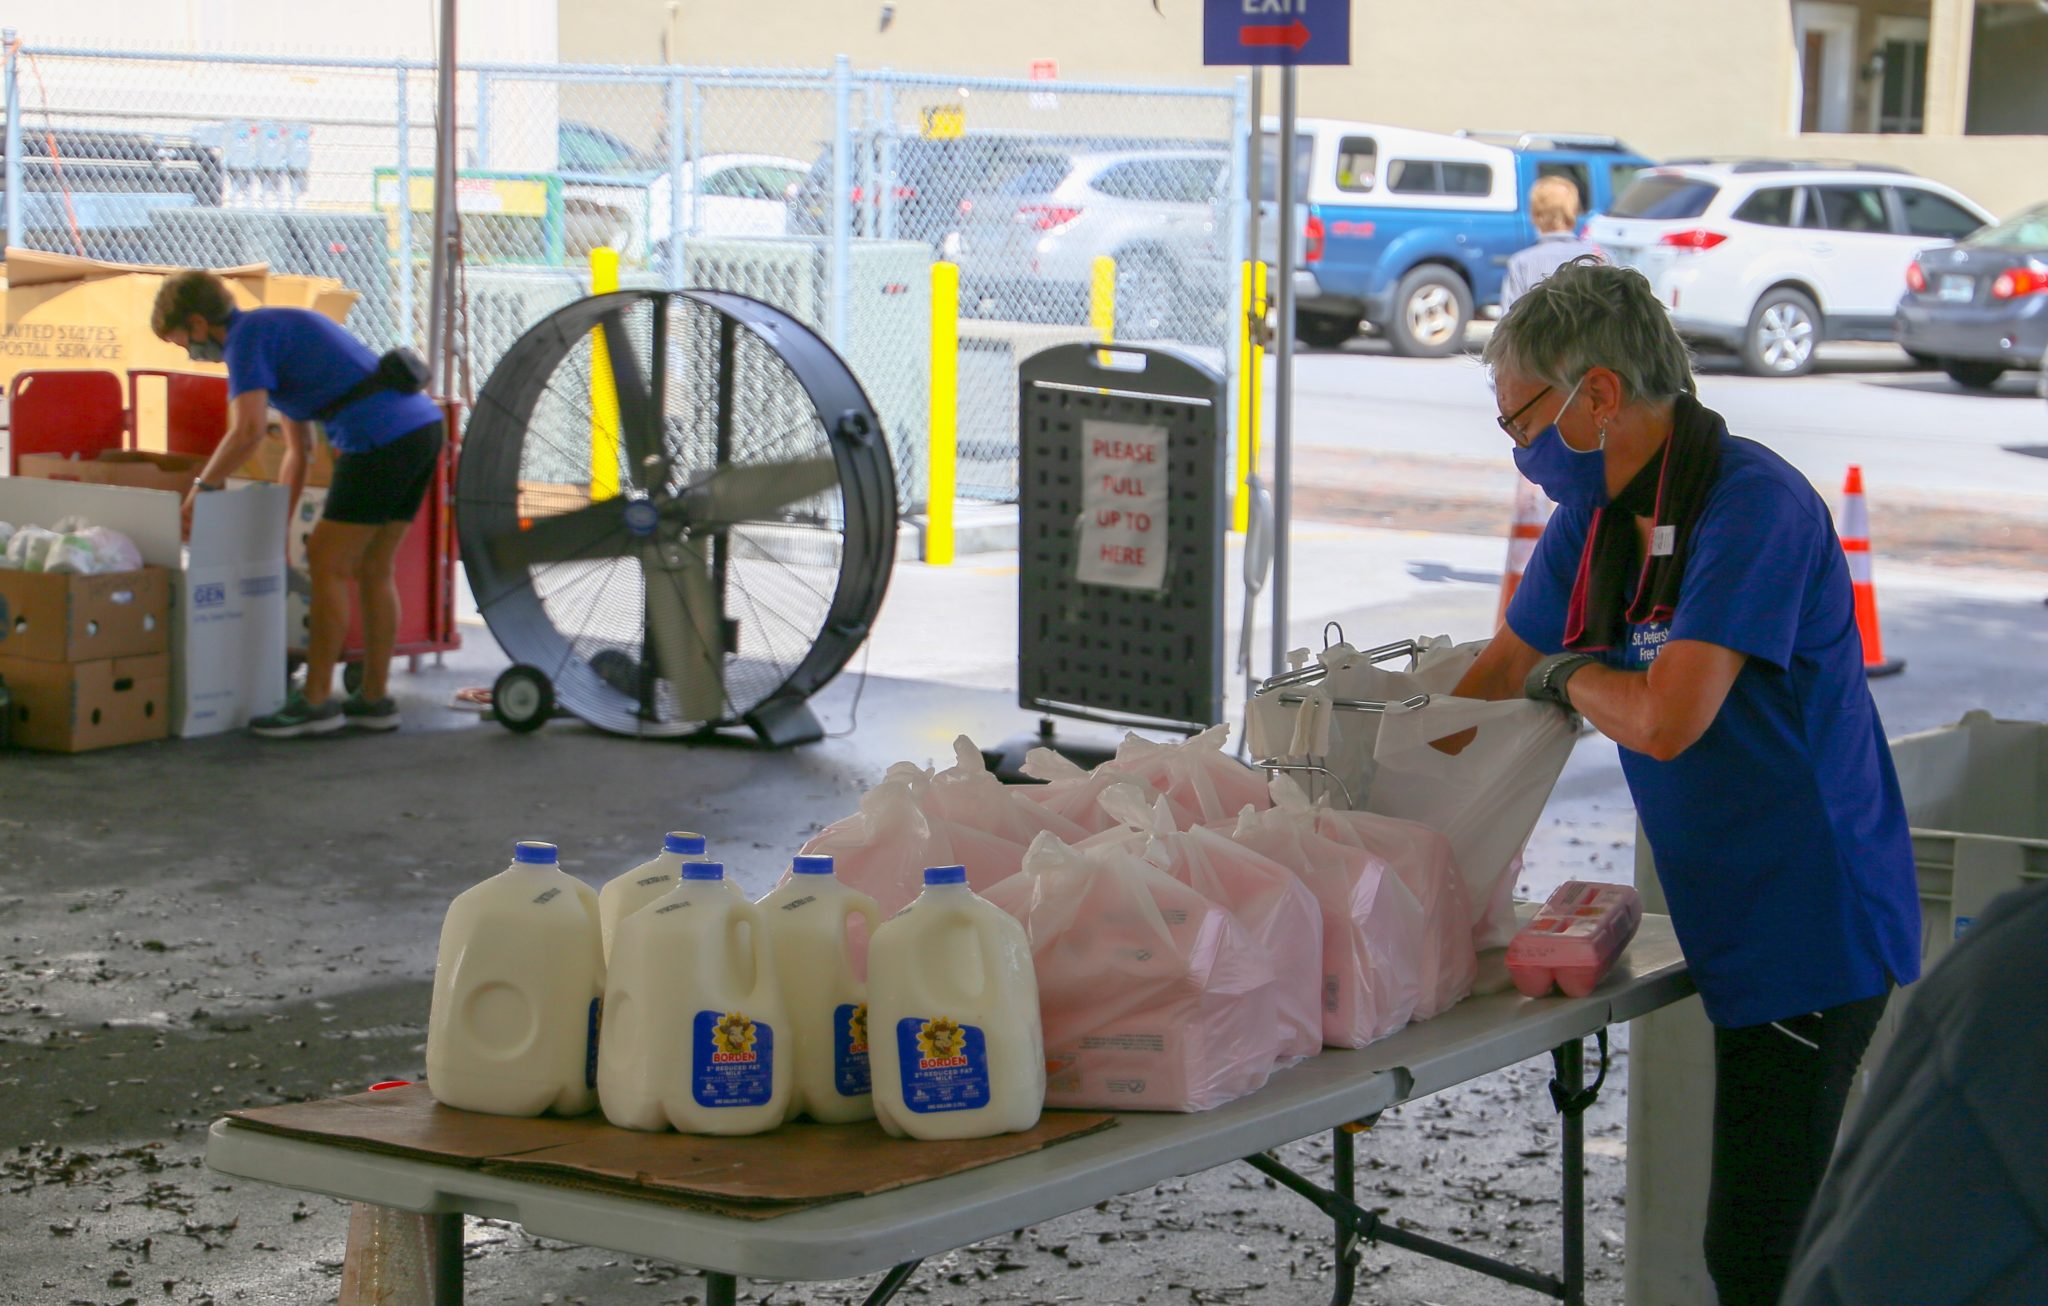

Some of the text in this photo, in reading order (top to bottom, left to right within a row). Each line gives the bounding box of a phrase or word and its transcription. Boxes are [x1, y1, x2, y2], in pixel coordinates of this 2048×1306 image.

[57, 325, 119, 341] STATES
[56, 342, 123, 359] SERVICE
[1092, 439, 1157, 463] PLEASE
[1103, 474, 1146, 497] PULL
[1096, 510, 1152, 532] UP TO
[1100, 544, 1146, 567] HERE
[1632, 627, 1670, 646] St. Peters
[1640, 647, 1654, 661] Free
[713, 1052, 757, 1063] BORDEN
[919, 1055, 967, 1069] BORDEN
[924, 1069, 958, 1077] REDUCED
